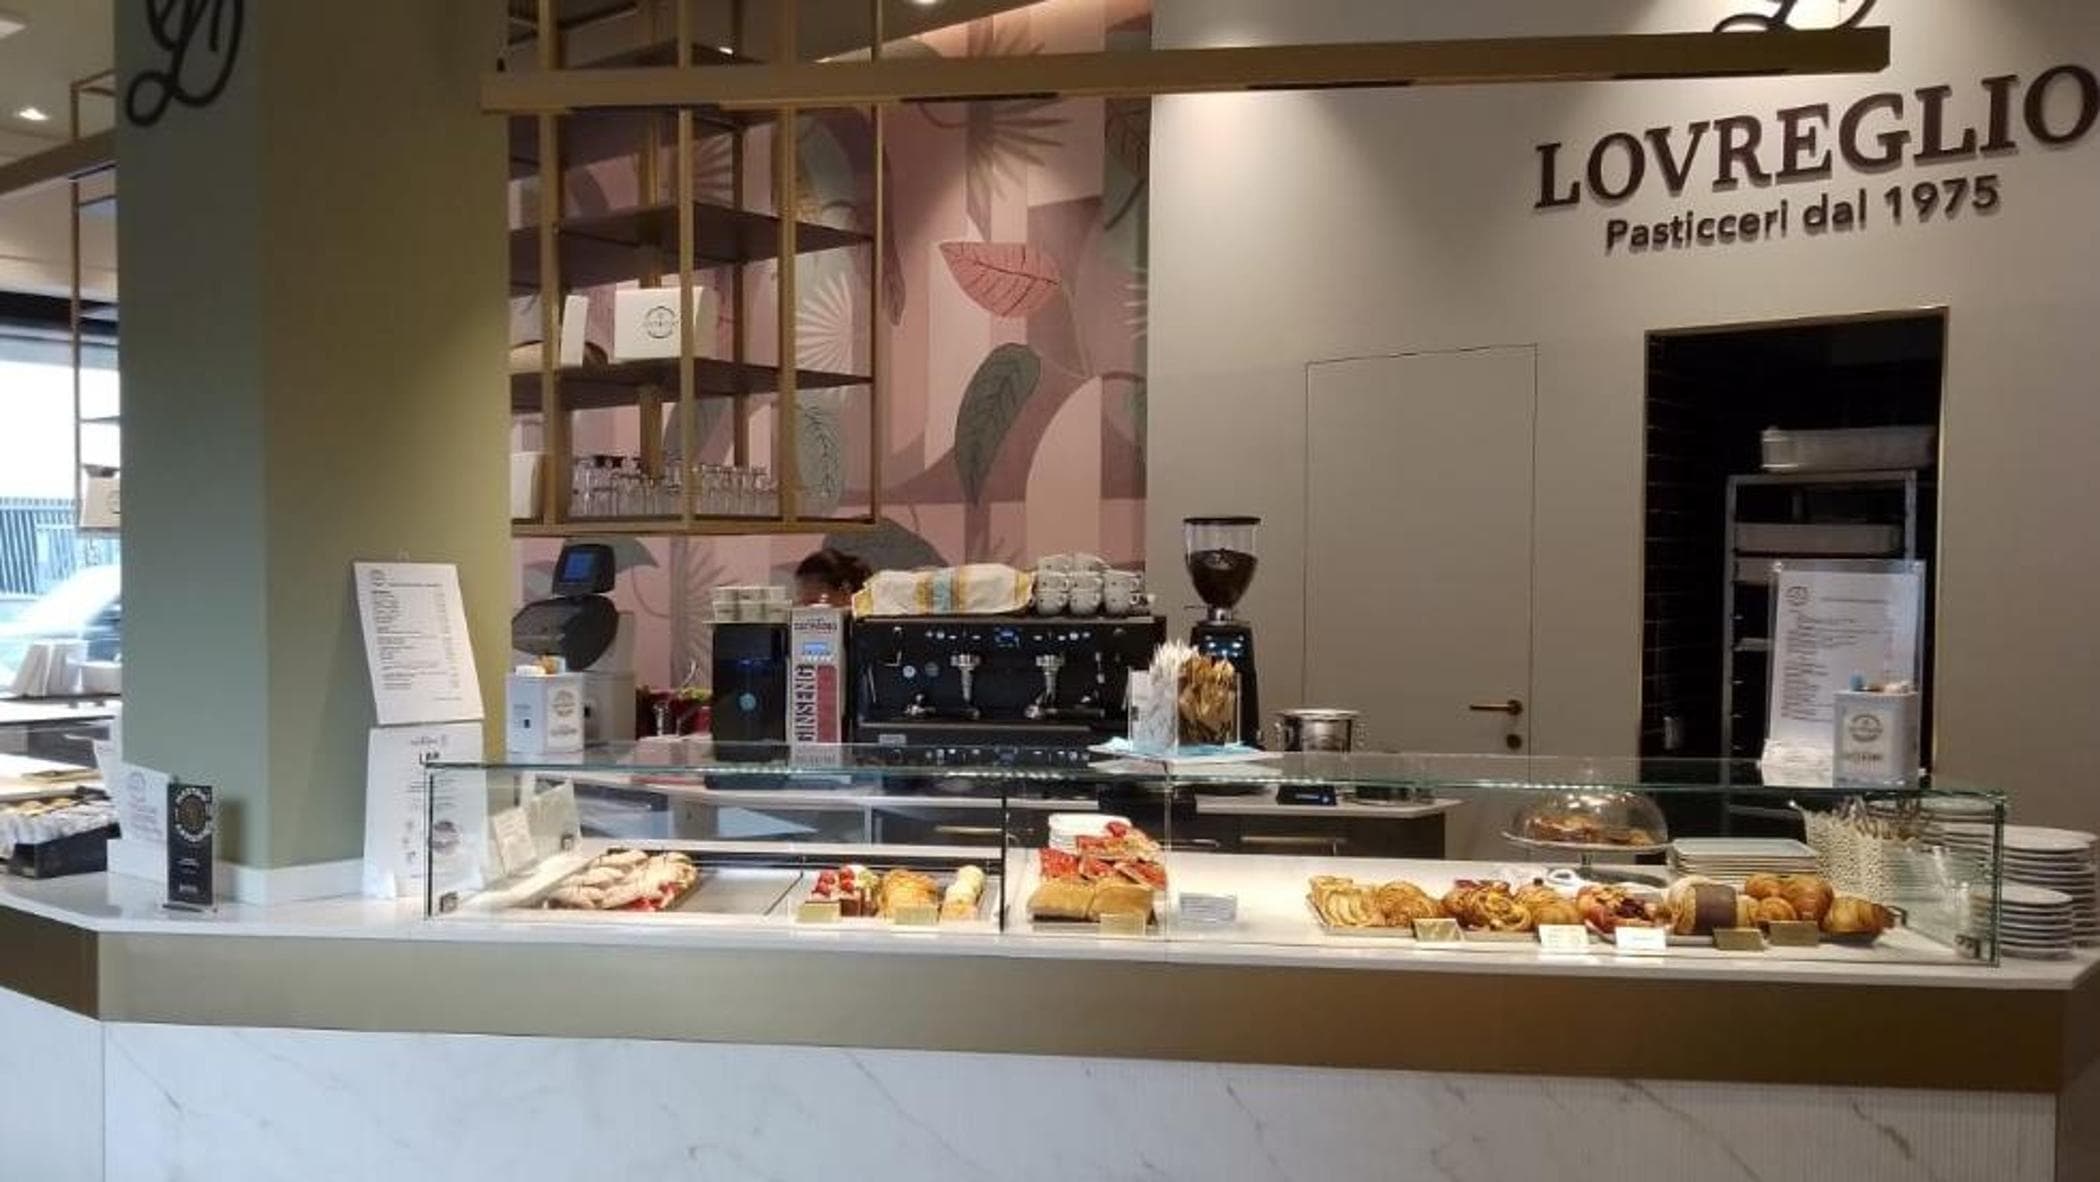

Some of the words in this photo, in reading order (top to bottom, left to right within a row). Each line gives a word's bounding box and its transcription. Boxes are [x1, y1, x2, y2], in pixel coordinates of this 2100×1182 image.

[1533, 64, 2099, 209] LOVREGLIO
[1605, 199, 1788, 253] Pasticceri
[1802, 187, 1867, 231] dal
[1884, 173, 2002, 224] 1975
[795, 663, 817, 743] GINSENG
